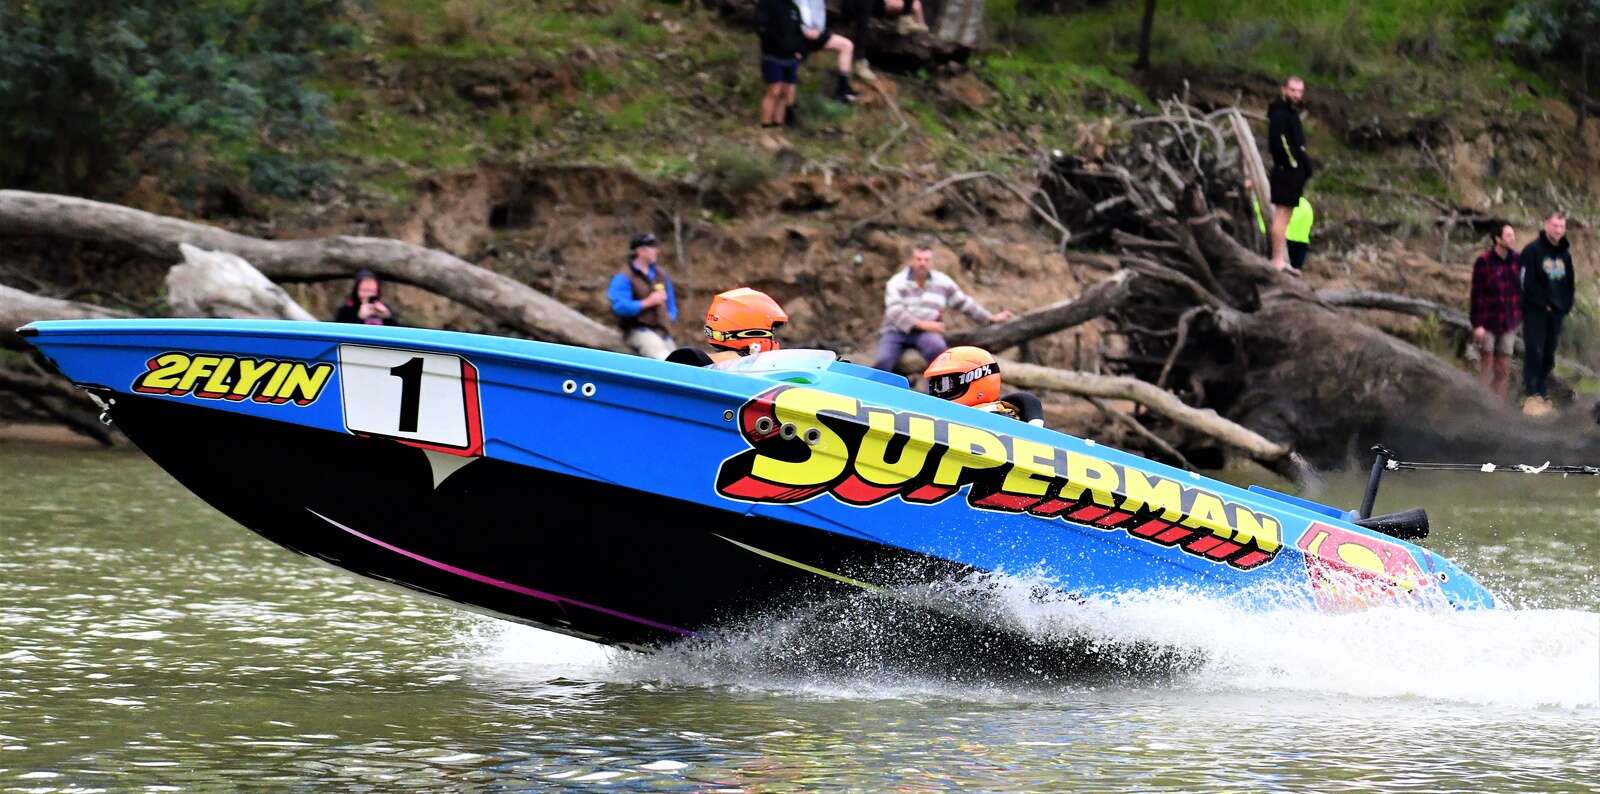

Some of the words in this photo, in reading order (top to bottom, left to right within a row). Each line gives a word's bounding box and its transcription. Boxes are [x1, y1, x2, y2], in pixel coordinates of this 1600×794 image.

[138, 353, 333, 402] 2FLYIN
[390, 357, 424, 433] 1
[959, 364, 993, 385] 100%
[749, 386, 1281, 554] SUPERMAN
